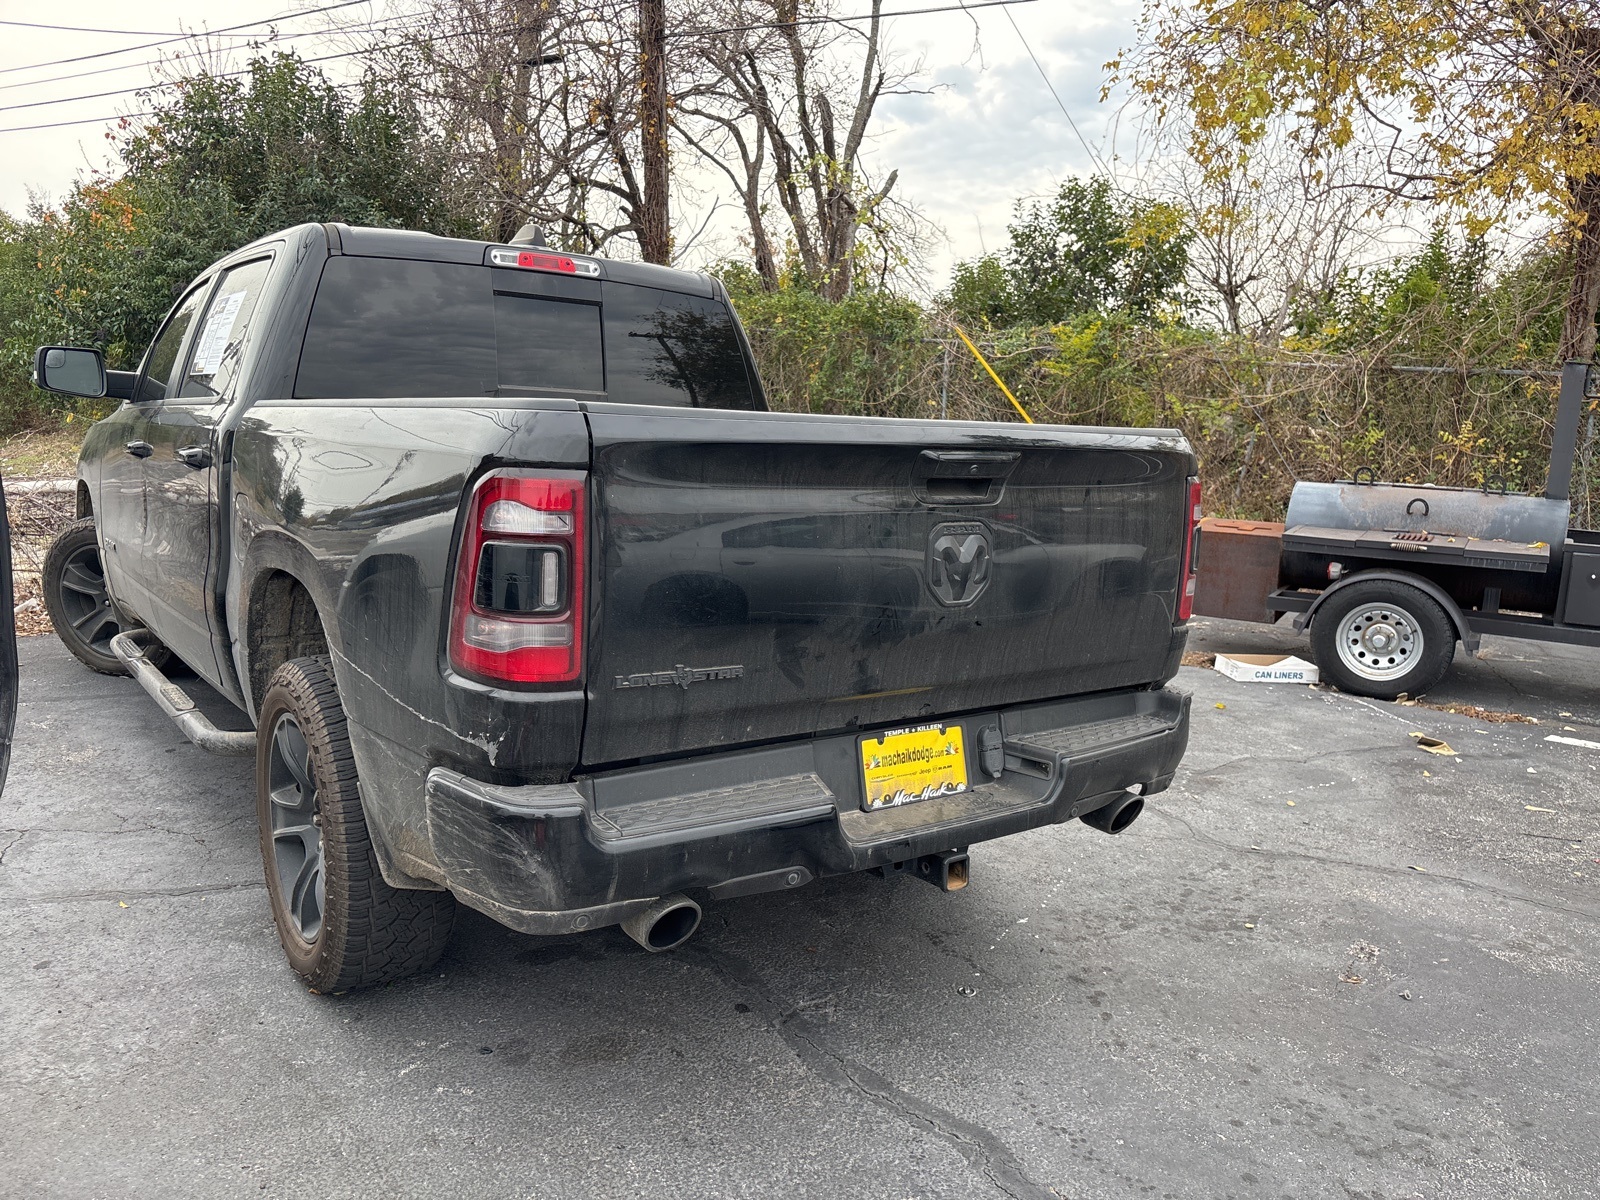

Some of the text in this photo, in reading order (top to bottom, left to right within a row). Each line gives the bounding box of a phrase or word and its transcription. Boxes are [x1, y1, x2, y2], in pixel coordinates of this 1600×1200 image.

[612, 665, 744, 690] LONE STAR
[1254, 671, 1304, 680] CAN LINERS
[884, 723, 943, 738] TEMPLE KILLEEN
[881, 746, 945, 768] machaikdodge.com
[893, 790, 917, 806] Mac
